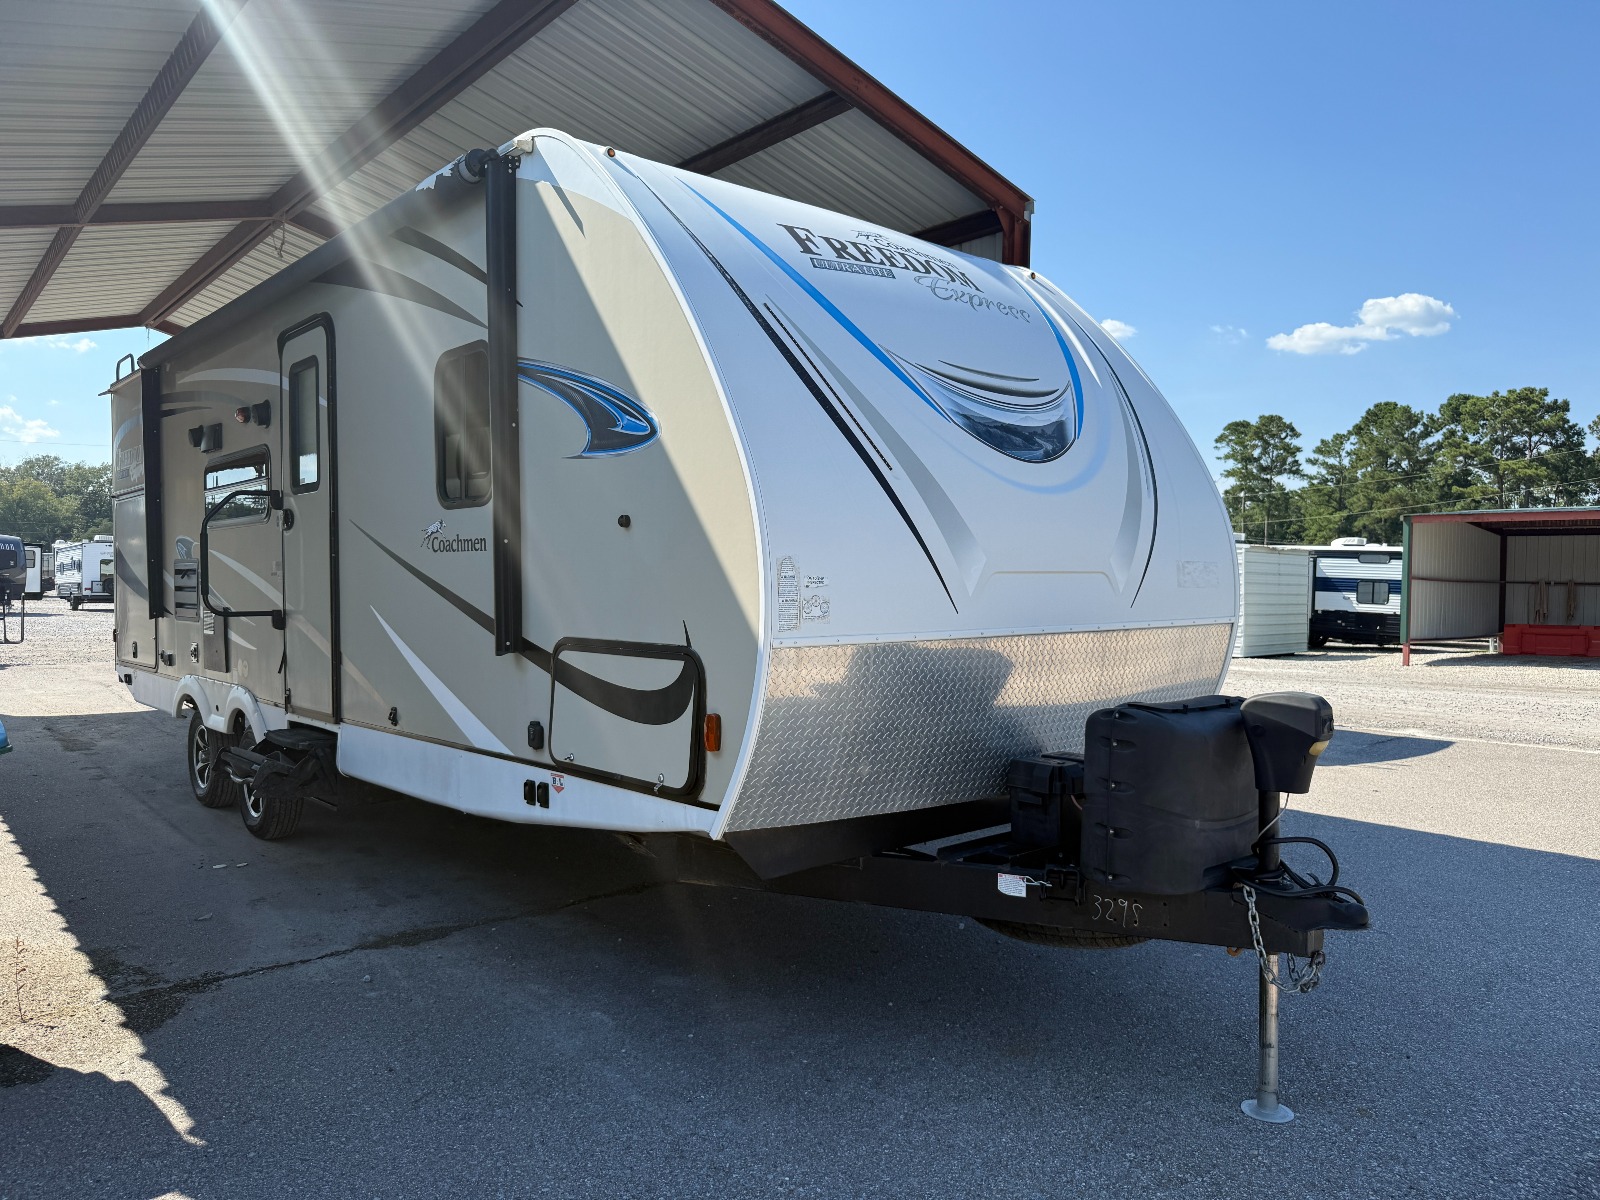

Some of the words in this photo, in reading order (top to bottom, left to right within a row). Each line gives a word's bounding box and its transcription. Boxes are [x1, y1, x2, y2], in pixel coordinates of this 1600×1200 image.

[776, 222, 984, 293] FREEDOM
[913, 275, 1031, 324] Express
[431, 533, 487, 553] Coachmen
